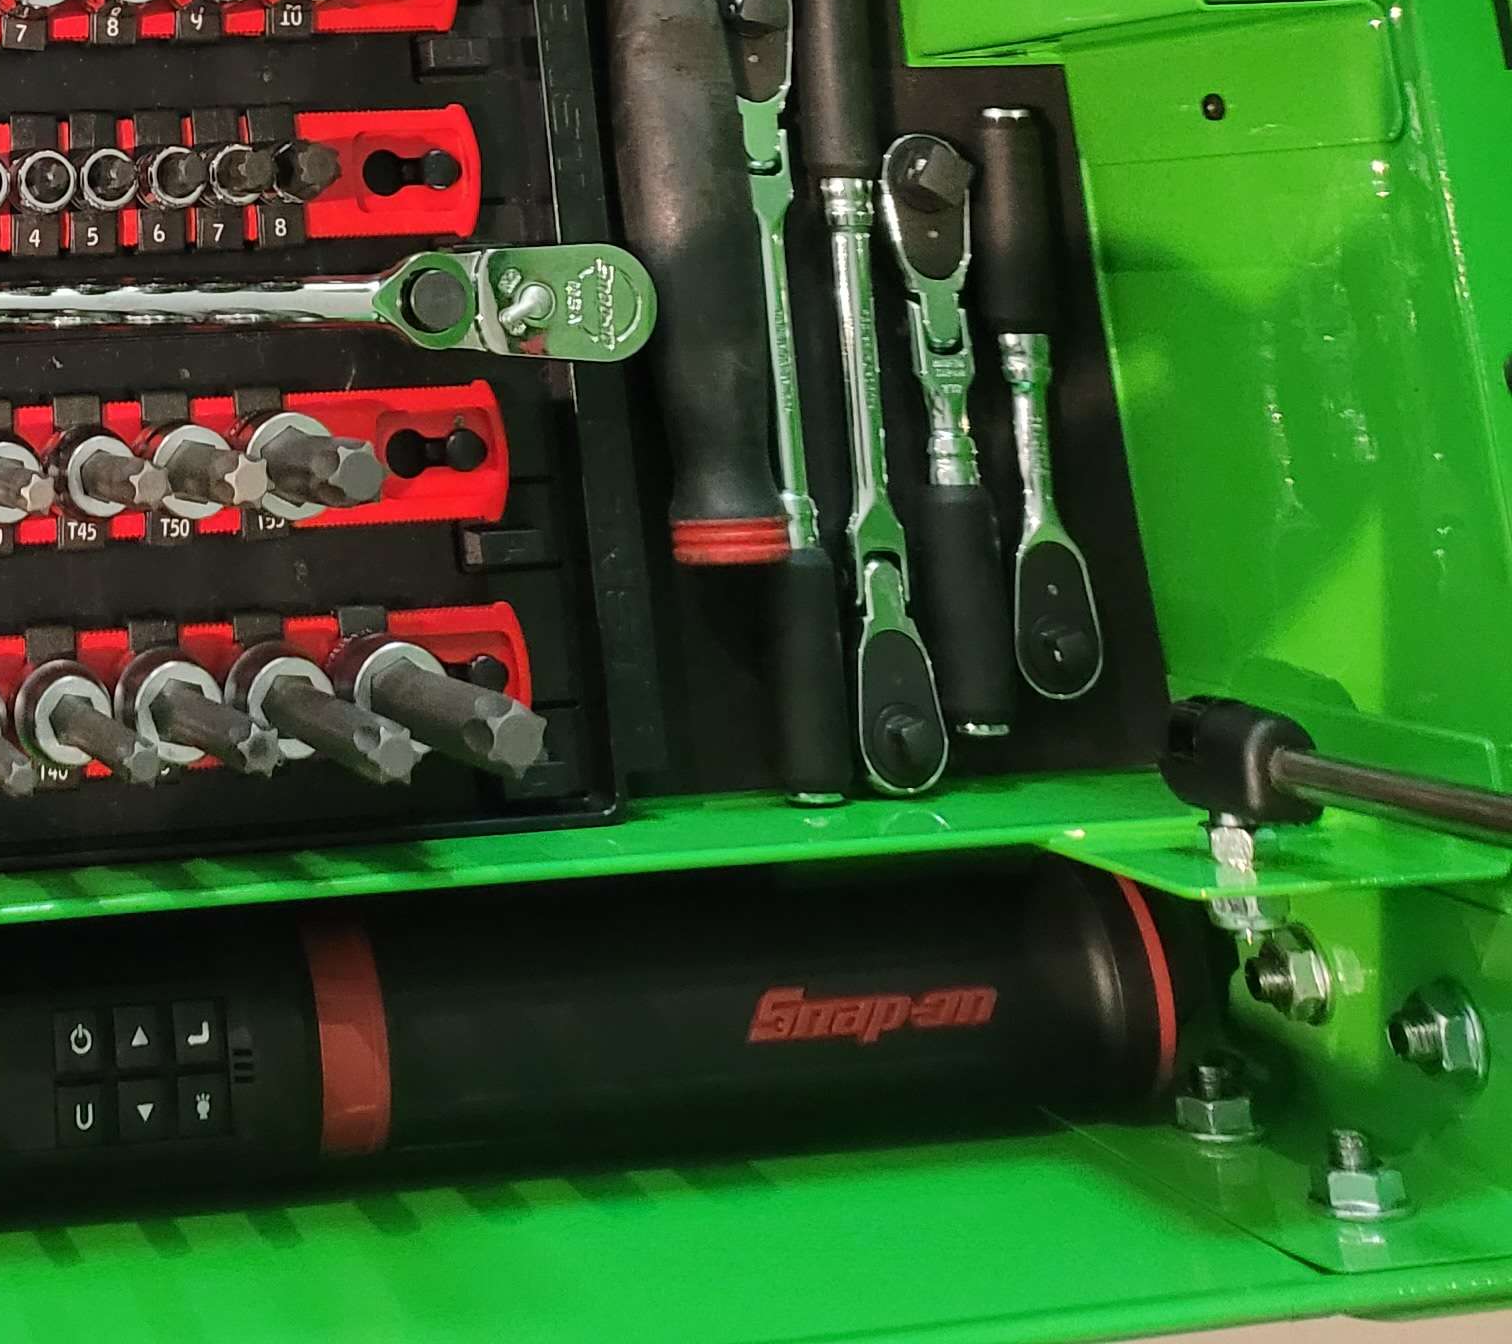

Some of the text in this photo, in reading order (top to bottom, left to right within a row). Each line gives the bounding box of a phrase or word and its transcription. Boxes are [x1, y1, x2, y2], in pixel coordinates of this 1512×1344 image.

[106, 18, 119, 37] 8
[191, 12, 204, 31] 9
[279, 8, 302, 28] 10
[15, 24, 28, 43] 7
[87, 227, 100, 247] 5
[152, 224, 167, 244] 6
[213, 223, 225, 243] 7
[274, 218, 288, 238] 8
[28, 229, 41, 249] 4
[68, 521, 97, 542] T45
[160, 518, 190, 539] T50
[748, 984, 998, 1046] Snap-on
